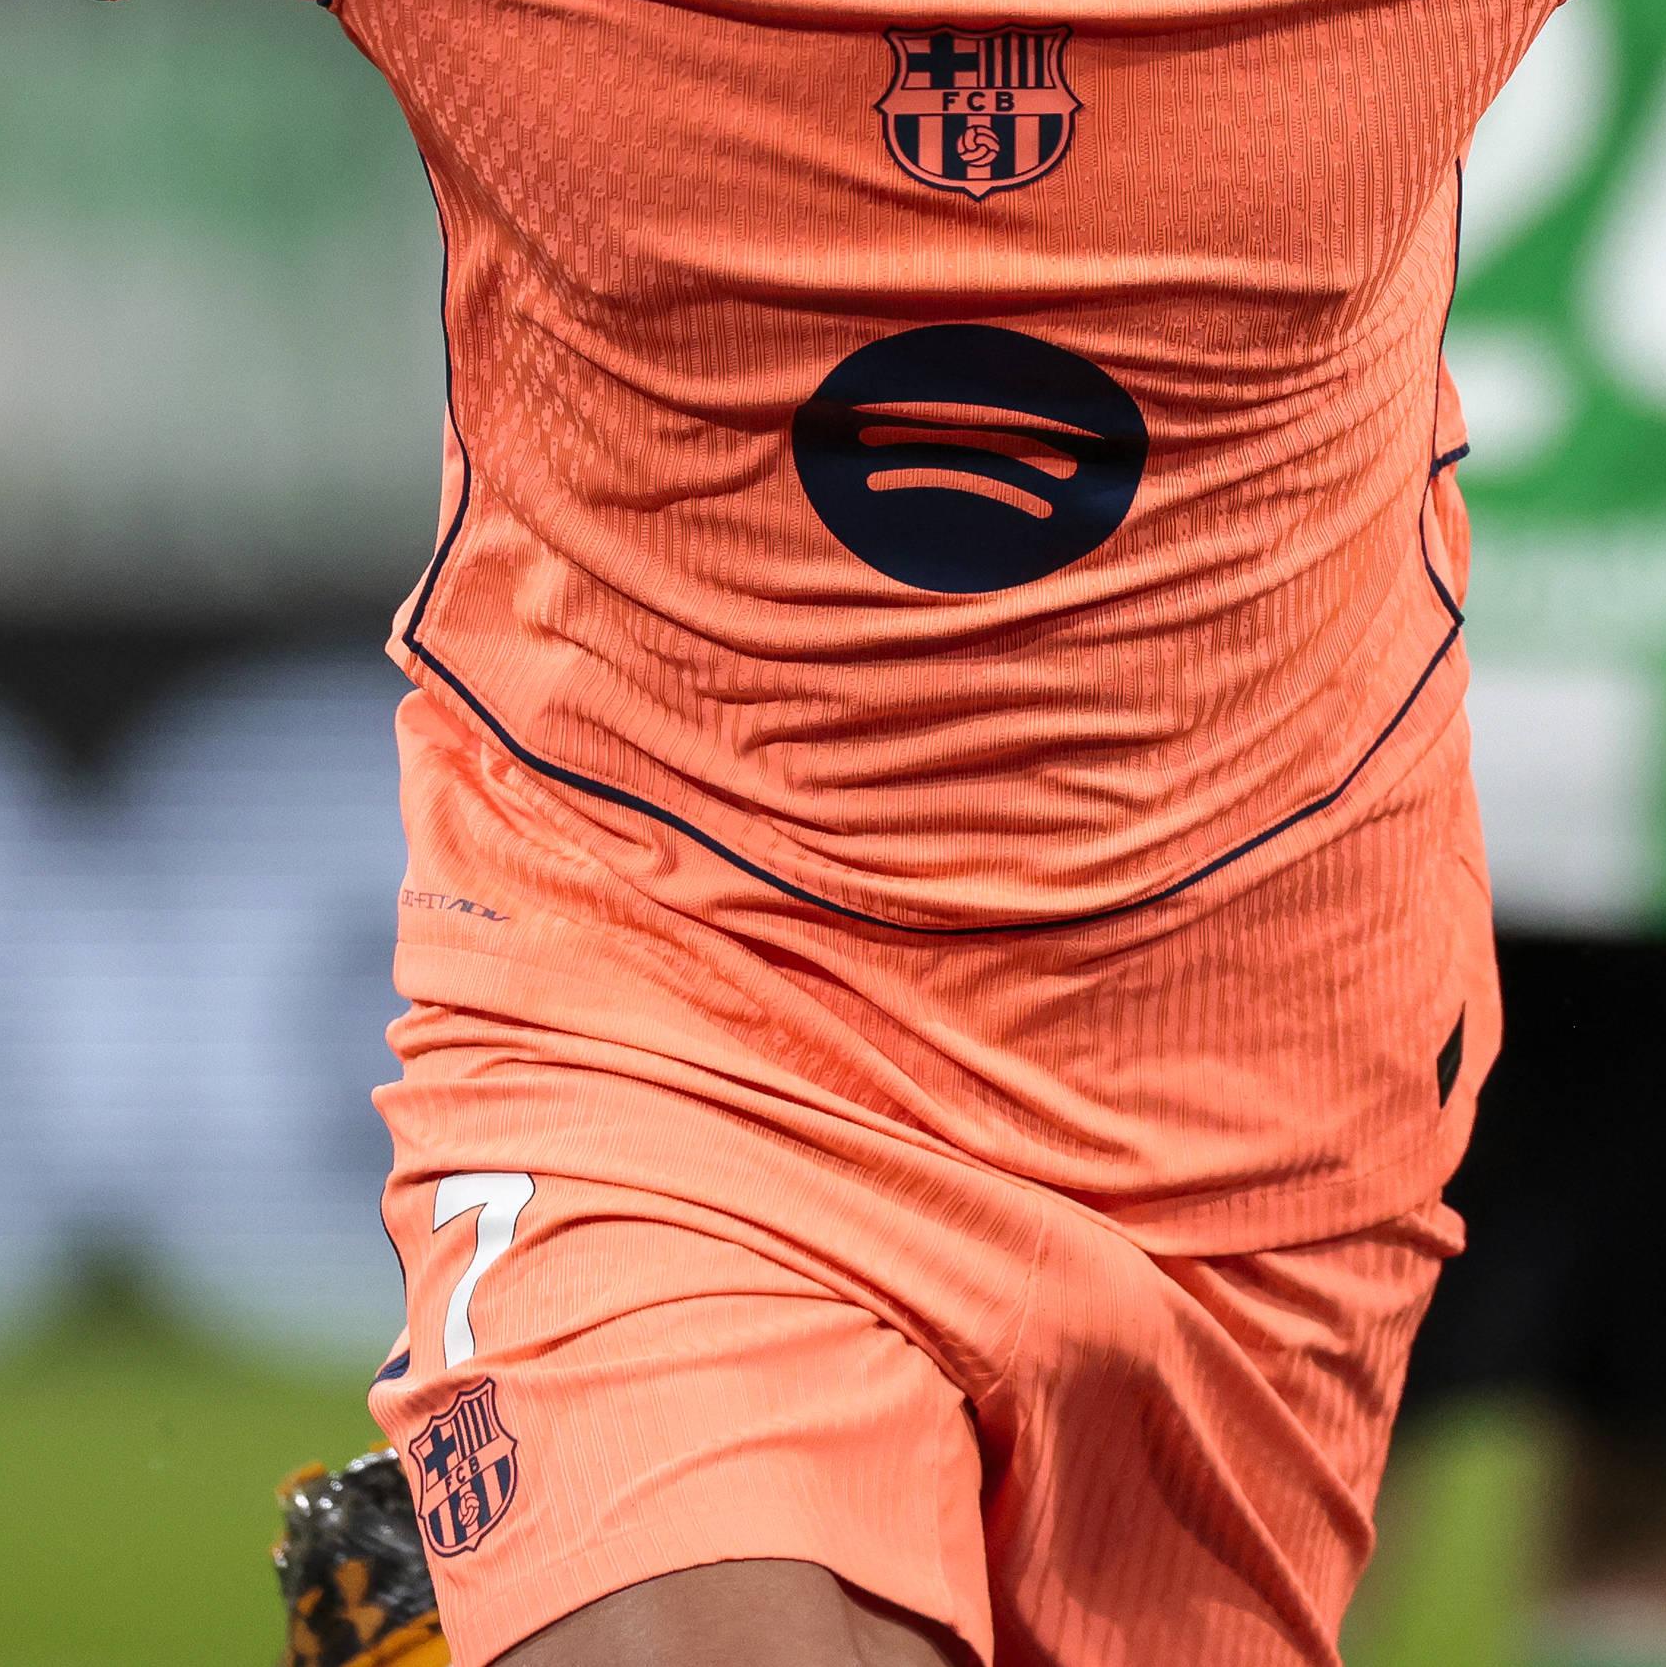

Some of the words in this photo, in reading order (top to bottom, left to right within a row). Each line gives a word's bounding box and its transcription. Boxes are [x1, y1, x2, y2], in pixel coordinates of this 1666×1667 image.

[942, 91, 1015, 112] FCB
[433, 1171, 536, 1370] 7
[445, 1455, 480, 1495] FCB
